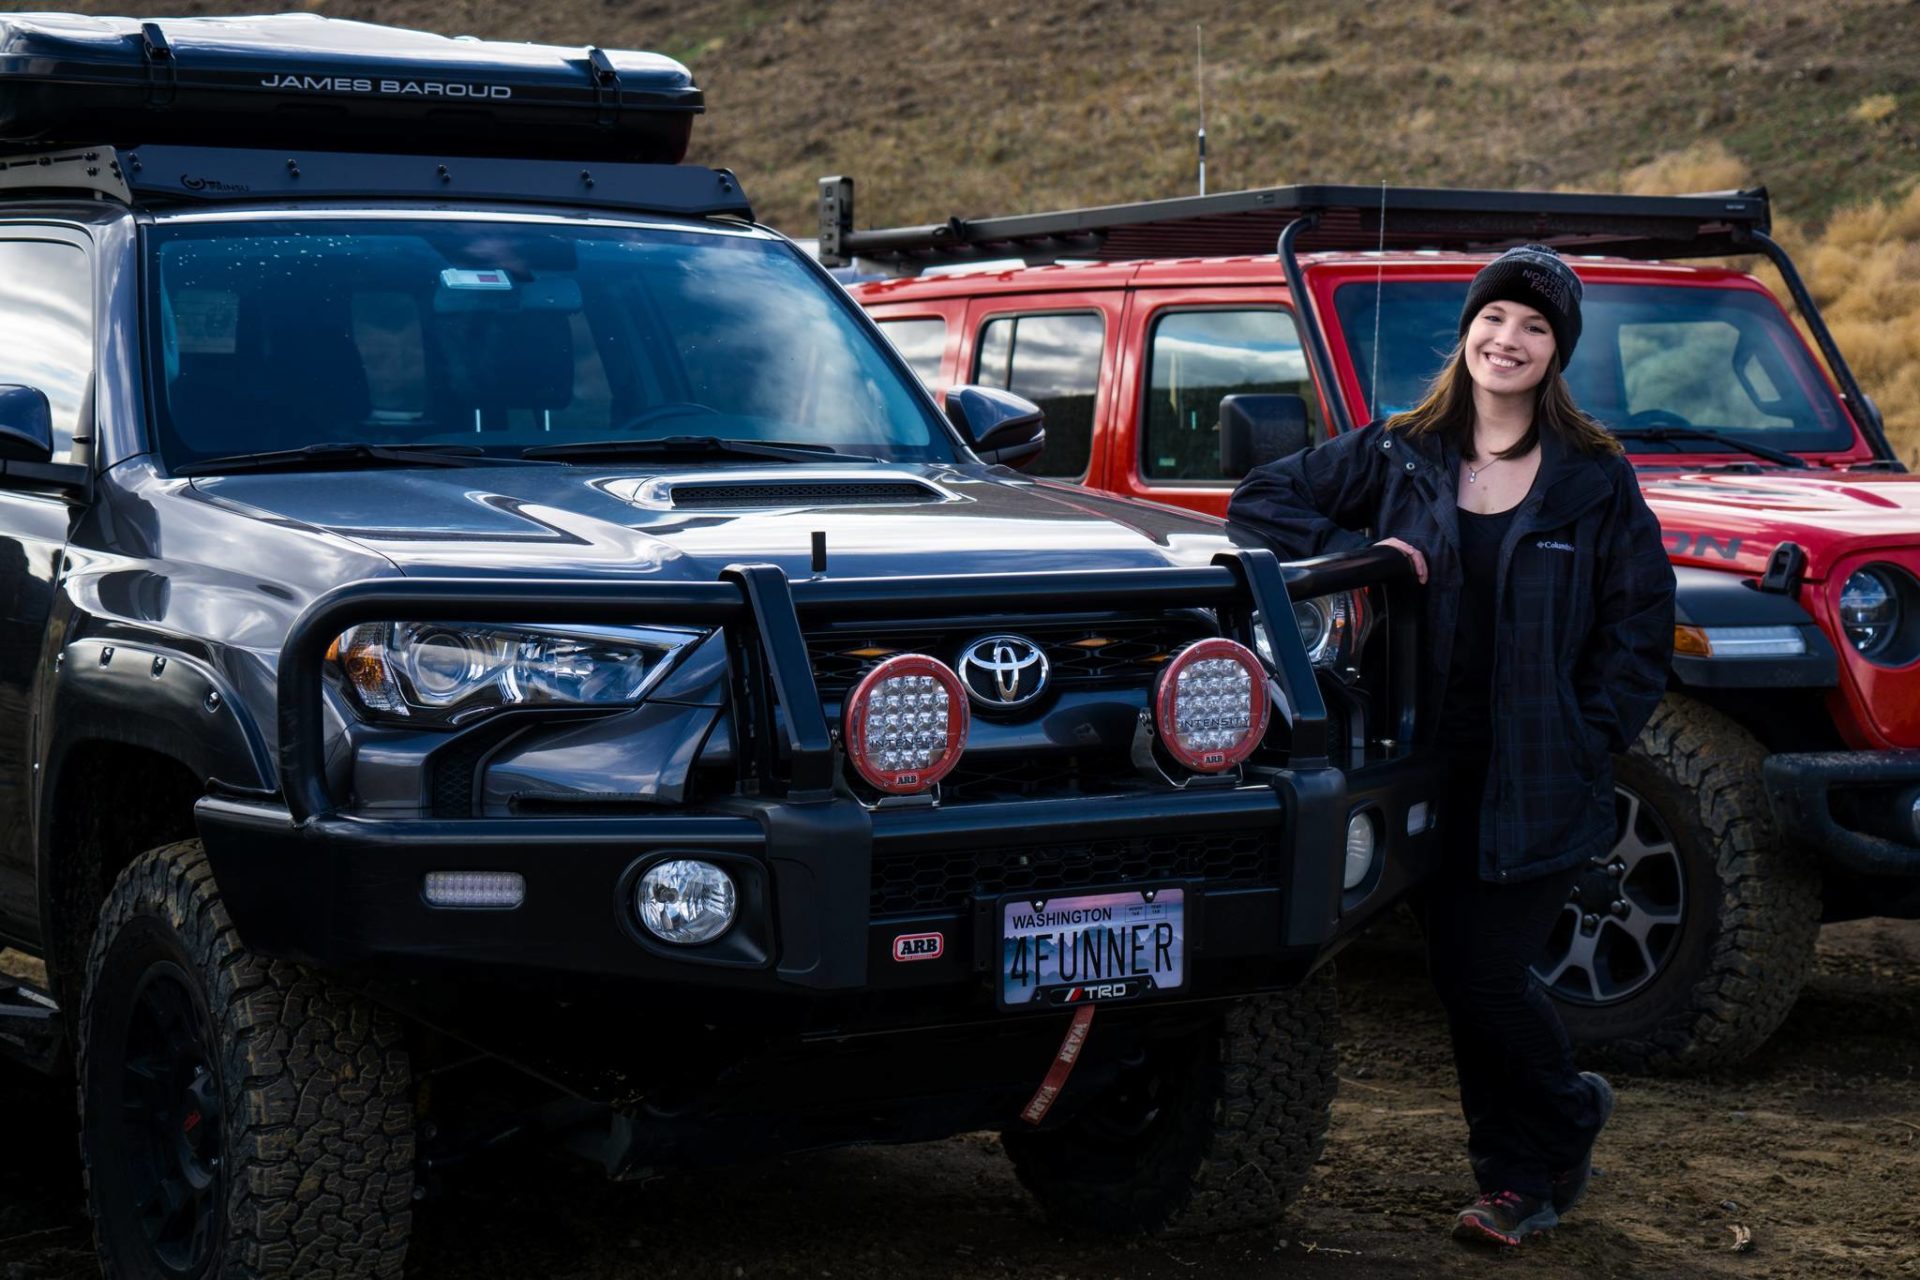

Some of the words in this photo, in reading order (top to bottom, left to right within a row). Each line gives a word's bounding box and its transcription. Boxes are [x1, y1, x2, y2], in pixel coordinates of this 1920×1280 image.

[260, 74, 373, 92] JAMES
[380, 80, 512, 99] BAROUD
[1522, 269, 1562, 296] NORTH
[1530, 280, 1560, 305] FACE
[1179, 716, 1250, 729] INTENSITY
[1205, 754, 1223, 764] ARB
[897, 775, 917, 784] ARB
[1012, 907, 1112, 930] WASHINGTON
[900, 938, 938, 956] ARB
[1011, 922, 1173, 987] 4FUNNER
[1084, 983, 1127, 999] TRD
[1060, 1023, 1088, 1063] WARN
[1026, 1086, 1057, 1120] WARN
